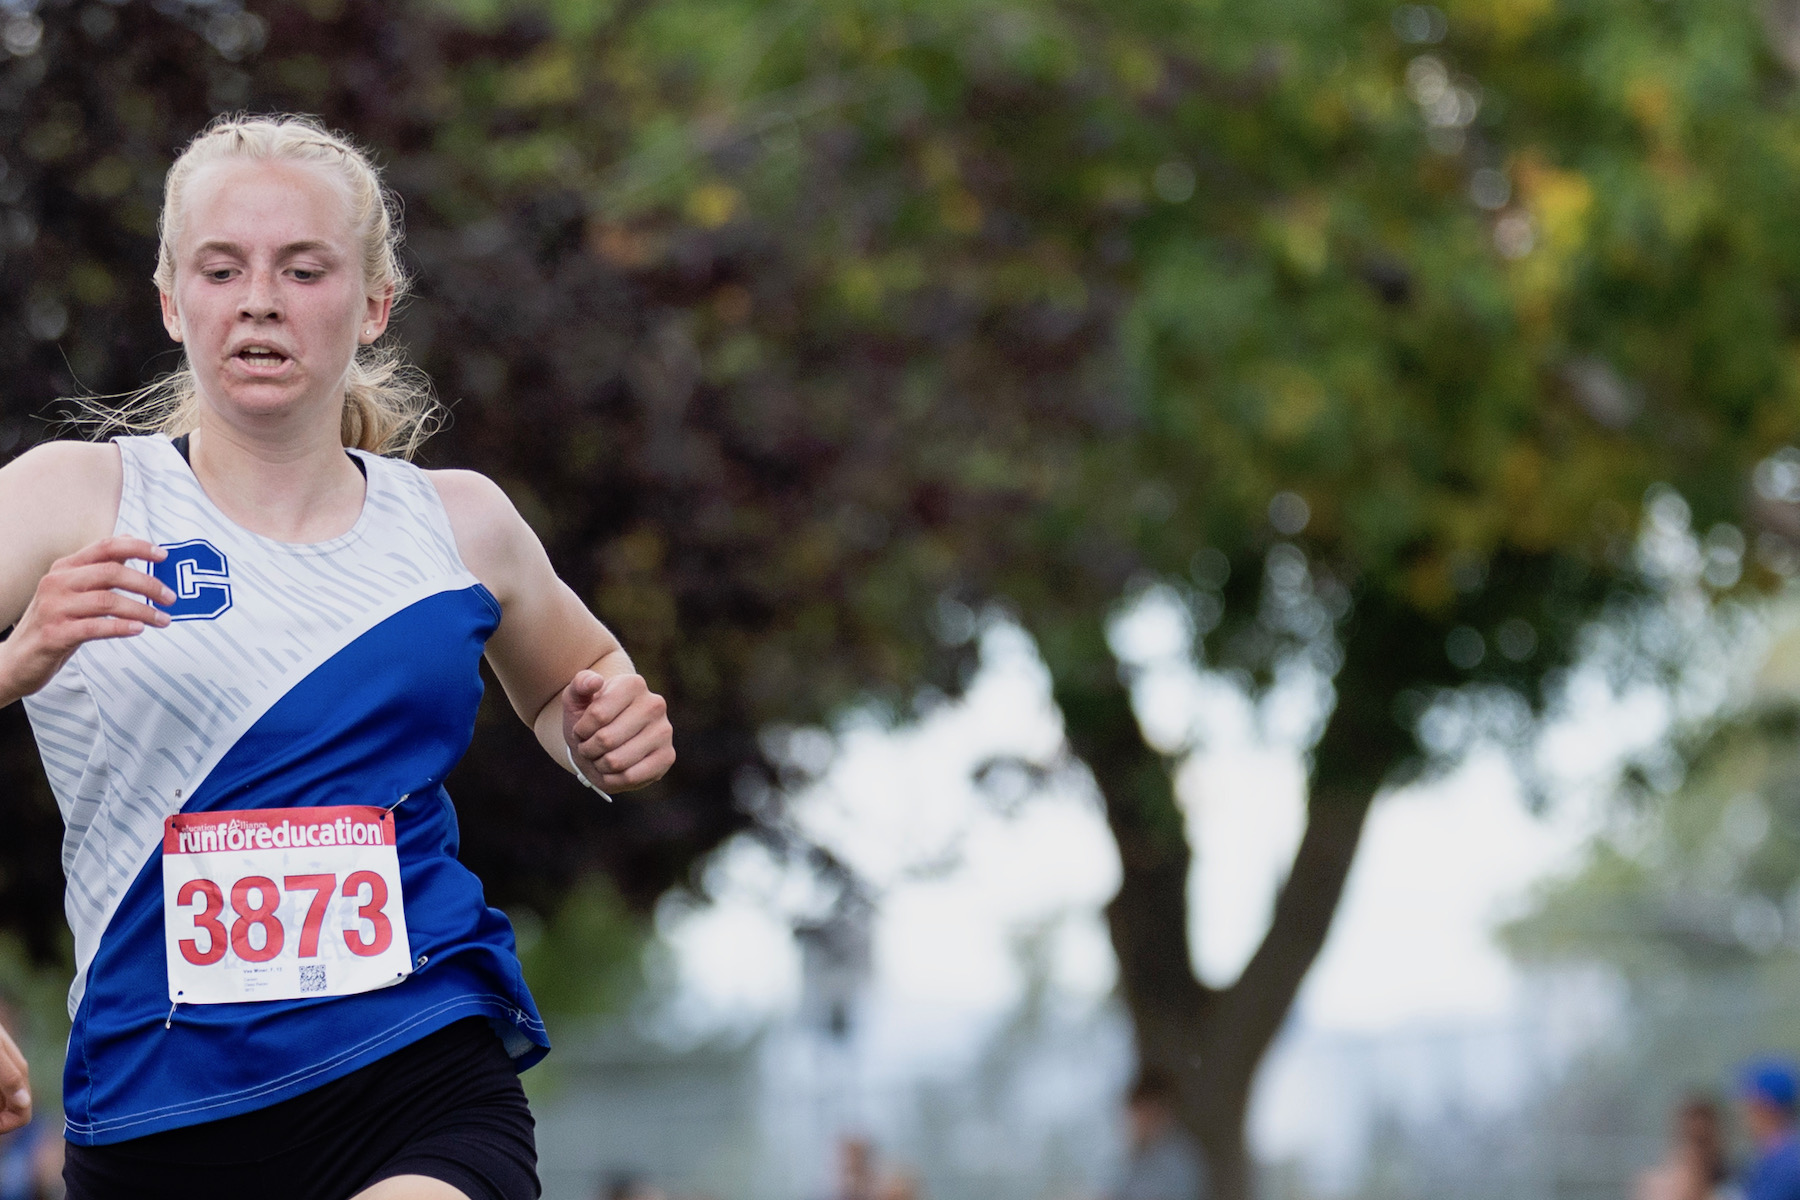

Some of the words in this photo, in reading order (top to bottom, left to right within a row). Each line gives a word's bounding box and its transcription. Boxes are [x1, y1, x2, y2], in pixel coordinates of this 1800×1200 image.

[146, 538, 233, 622] C
[179, 816, 382, 853] runforeducation
[176, 870, 393, 966] 3873
